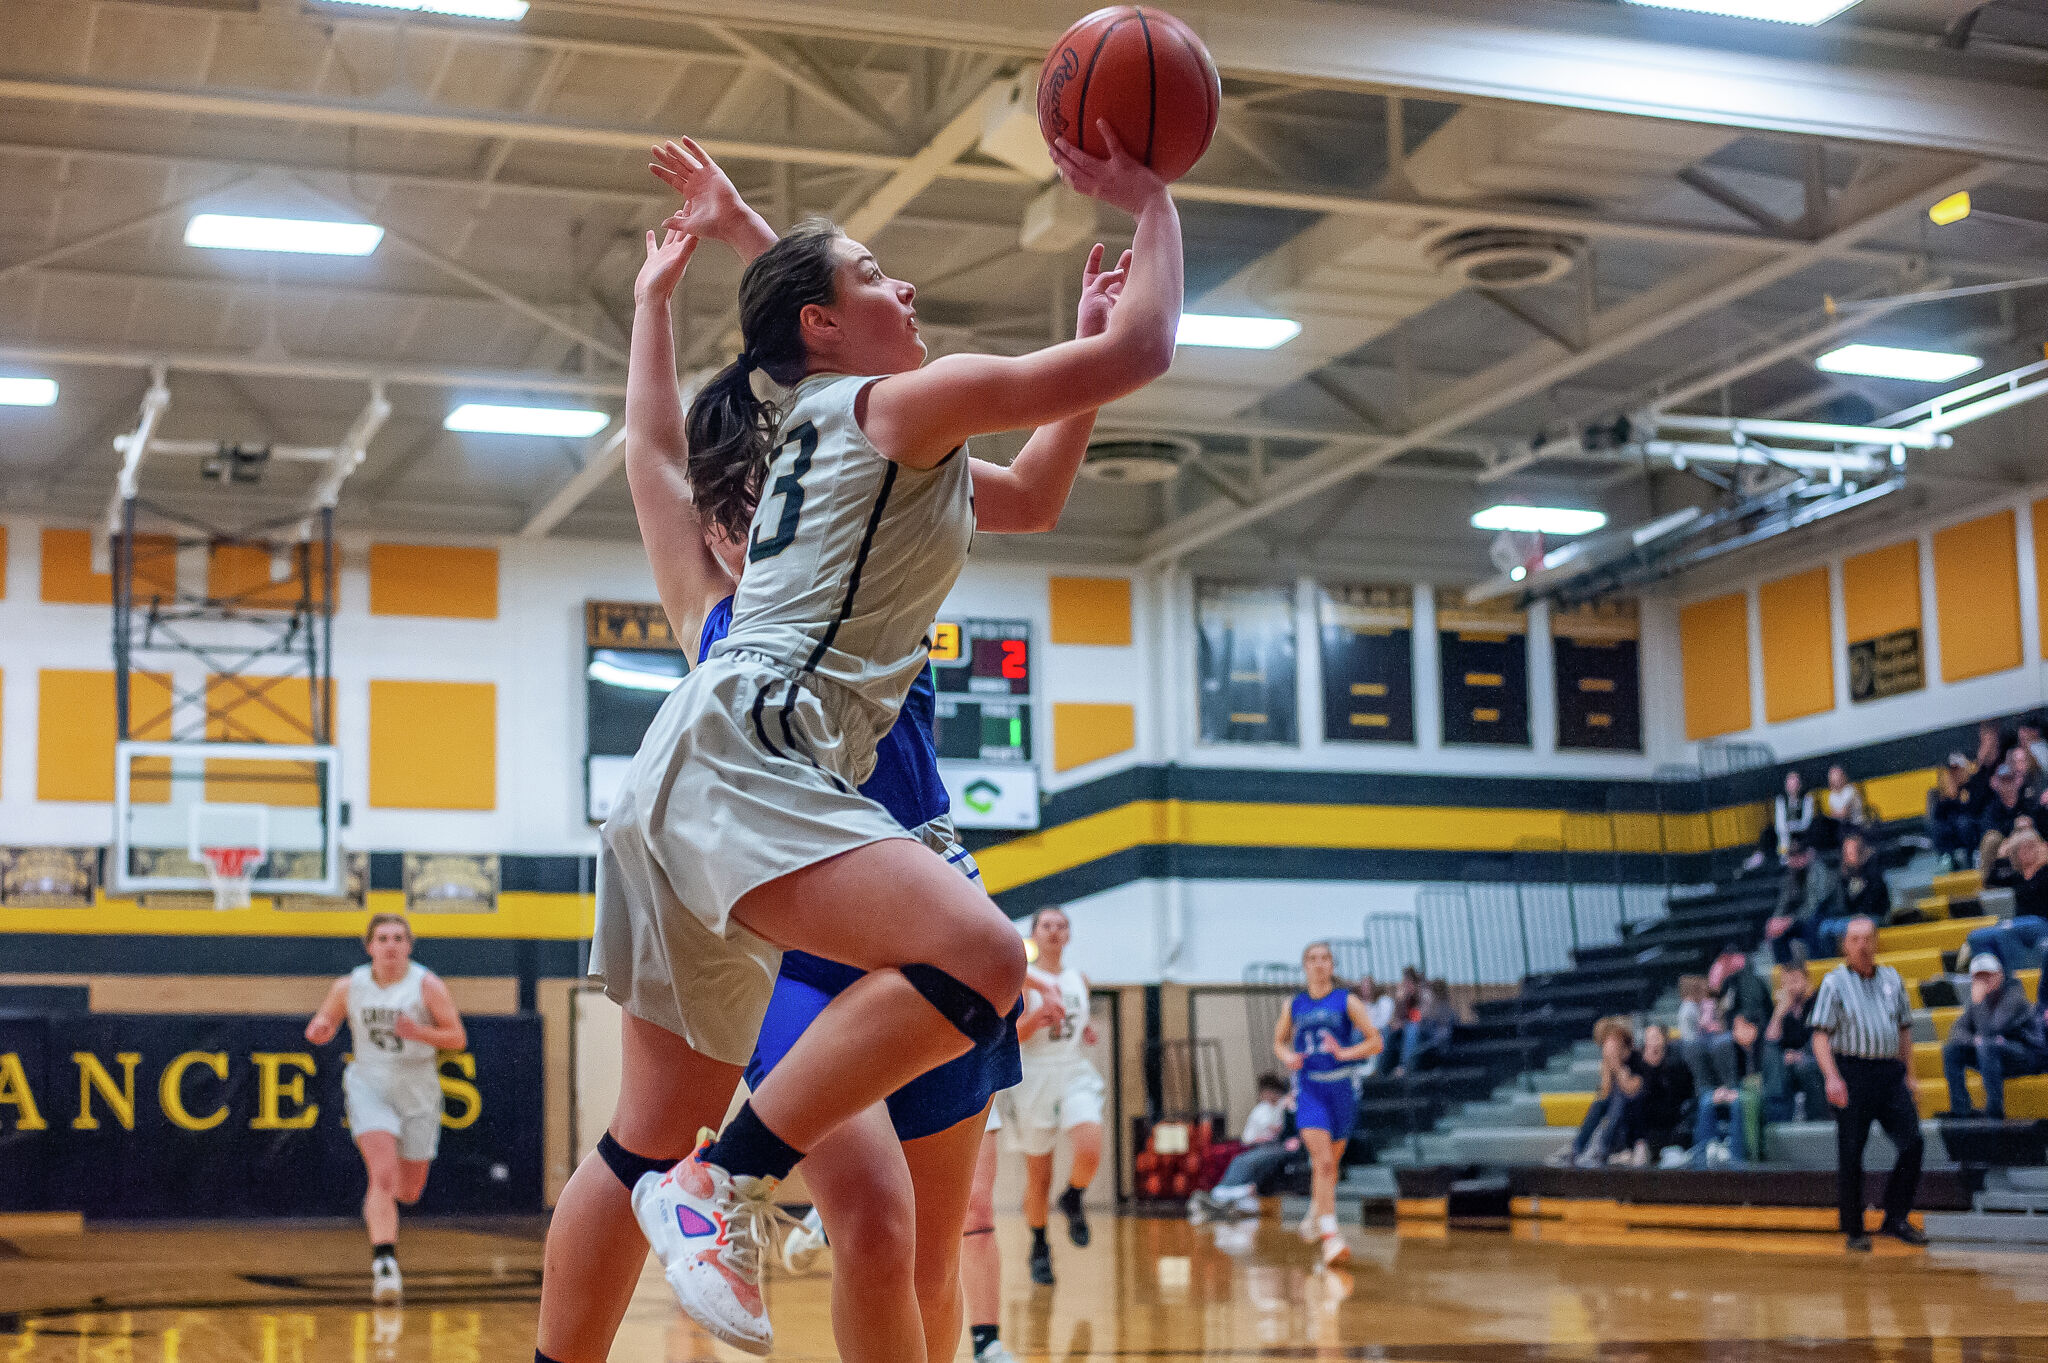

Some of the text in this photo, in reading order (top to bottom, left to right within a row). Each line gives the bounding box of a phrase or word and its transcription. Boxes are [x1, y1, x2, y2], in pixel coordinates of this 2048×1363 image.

[749, 420, 819, 564] 3
[1001, 640, 1027, 679] 2
[1009, 718, 1022, 747] 1
[0, 1052, 482, 1130] ANCES
